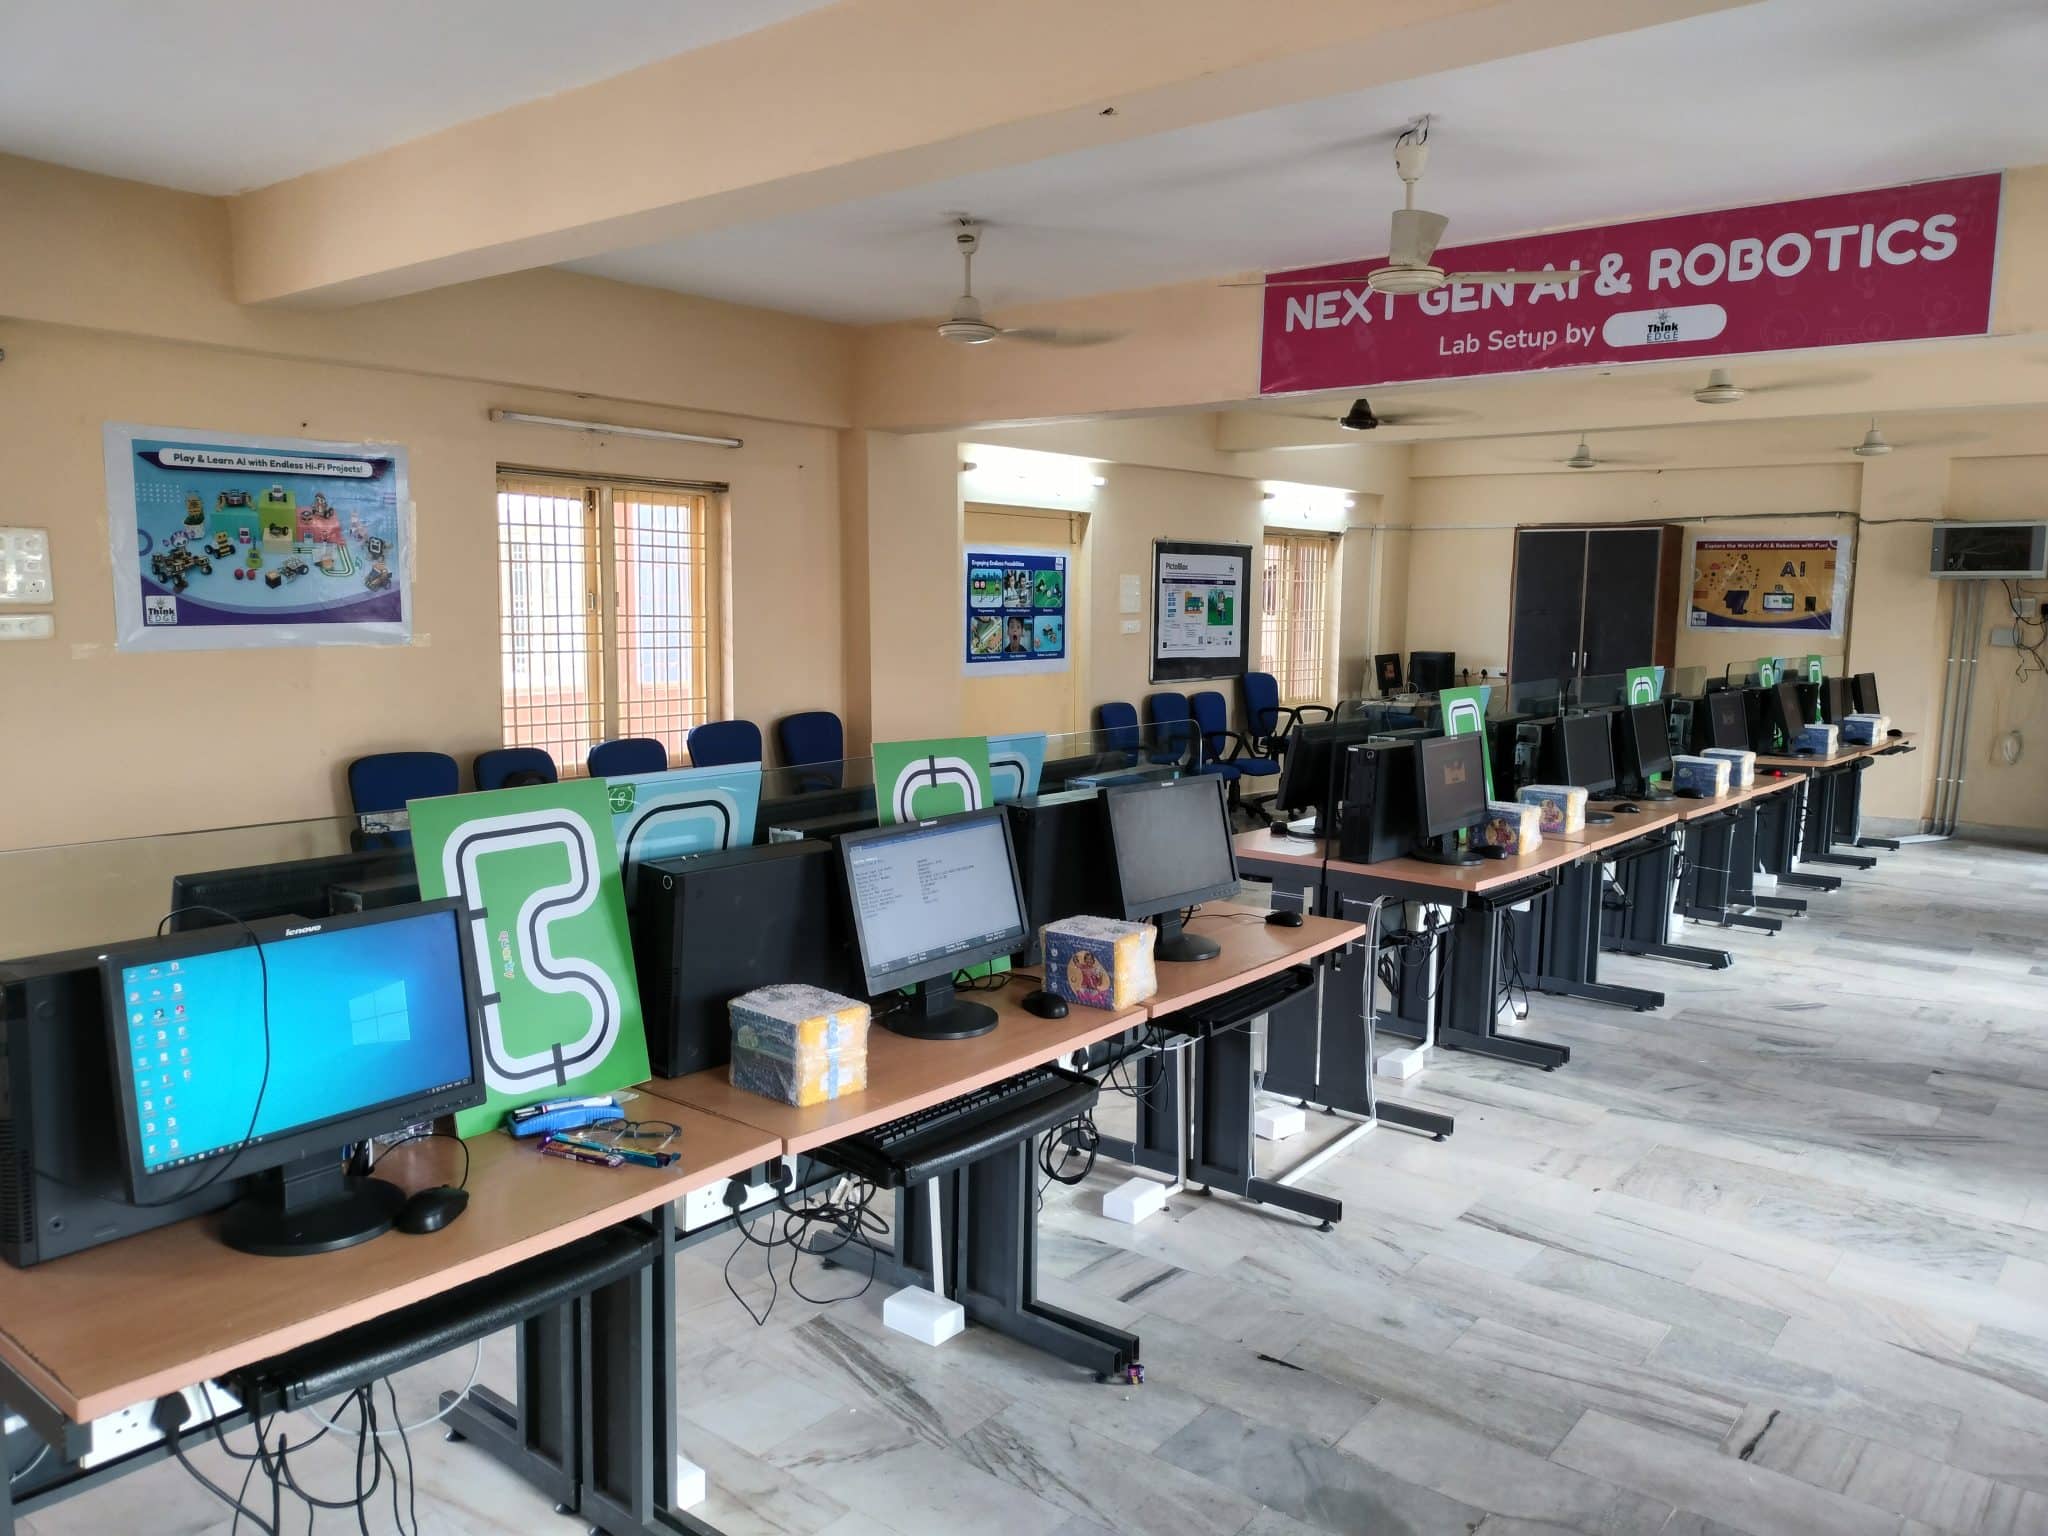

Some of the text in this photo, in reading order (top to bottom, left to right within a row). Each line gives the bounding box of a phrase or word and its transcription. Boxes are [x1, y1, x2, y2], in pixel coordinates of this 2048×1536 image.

[1419, 268, 1516, 316] GEN
[1527, 260, 1580, 305] AI
[1594, 253, 1632, 296] &
[1648, 214, 1958, 291] ROBOTICS
[1648, 321, 1679, 333] Think
[1439, 322, 1596, 356] Lab Setup by
[1647, 331, 1679, 341] EDGE
[173, 453, 363, 474] Play & Learn AI with Endless Hi-Fi Projects!
[1779, 560, 1806, 577] AI
[148, 607, 175, 615] Think
